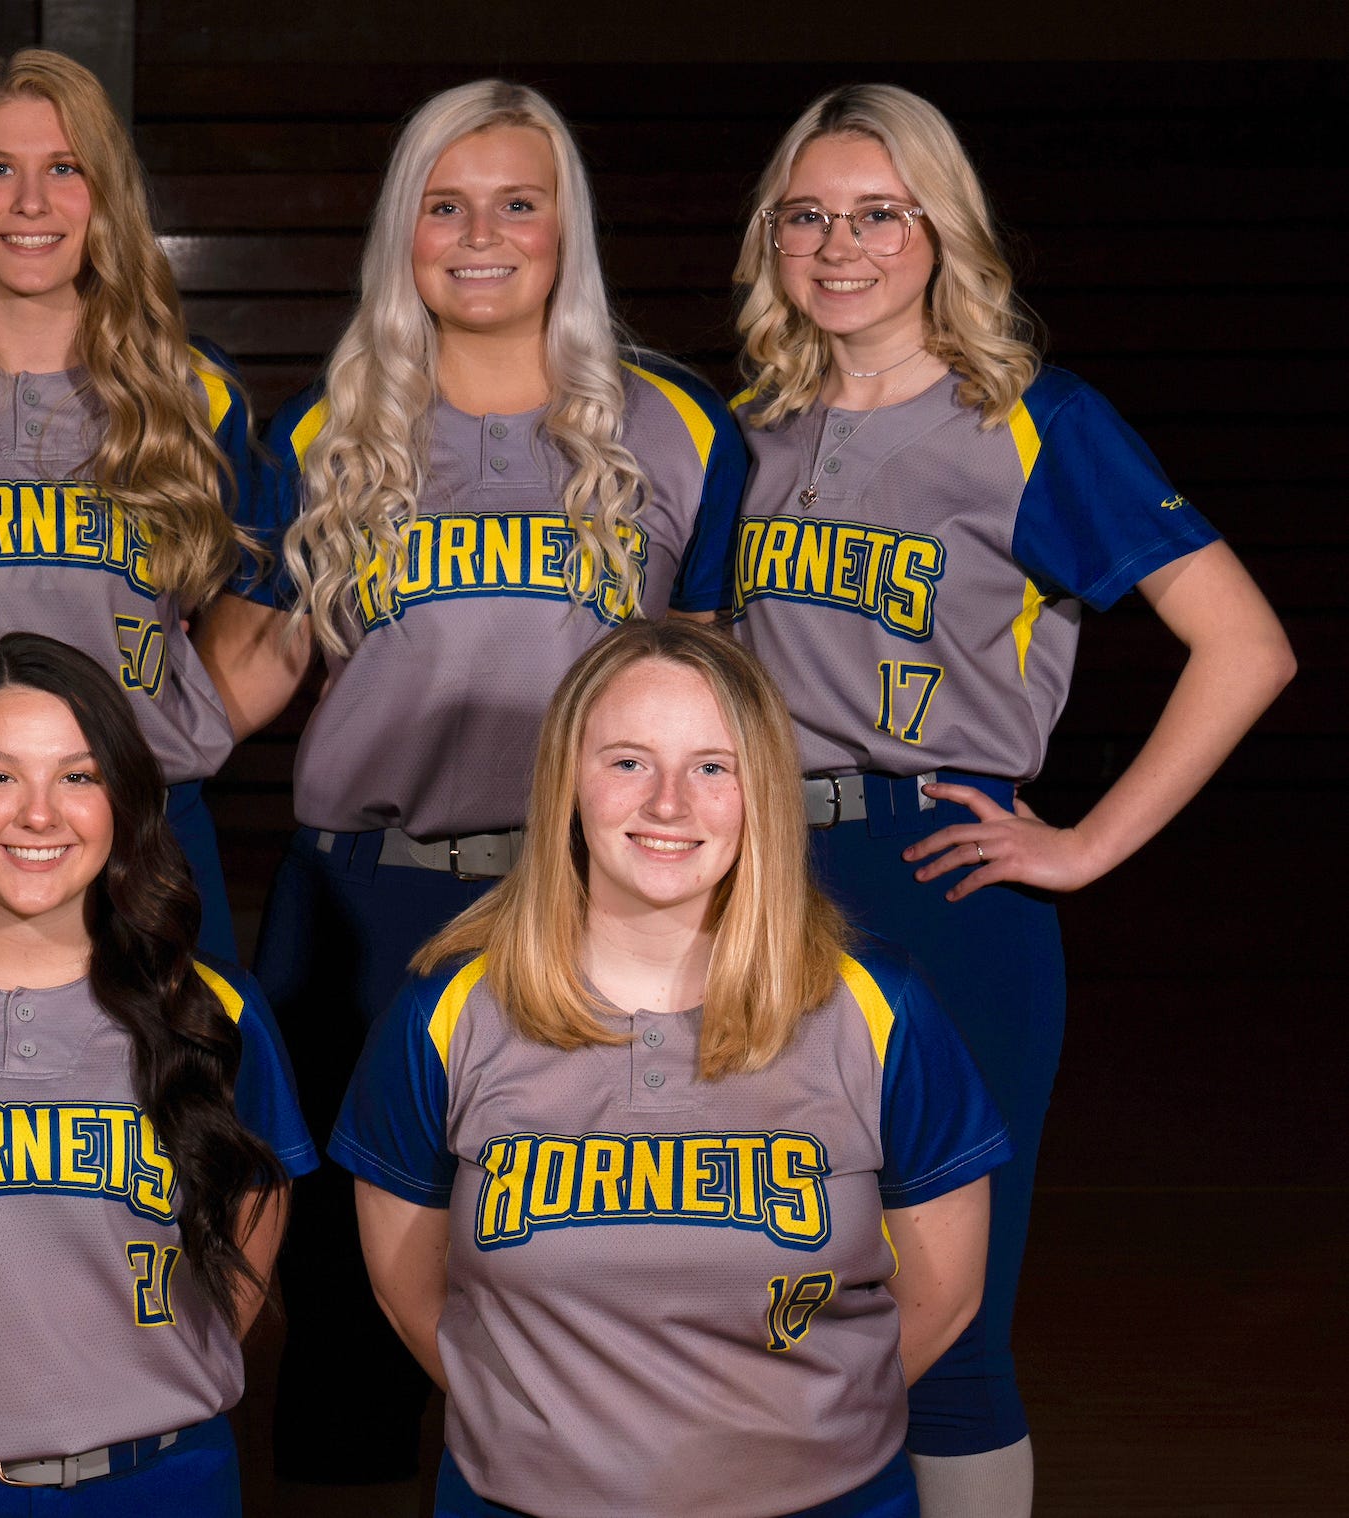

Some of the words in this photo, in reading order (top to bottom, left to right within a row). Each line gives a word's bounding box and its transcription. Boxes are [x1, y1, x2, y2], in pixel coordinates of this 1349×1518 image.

[113, 613, 165, 700] 50
[874, 660, 945, 744] 17
[474, 1129, 834, 1252] HORNETS
[125, 1240, 182, 1327] 21
[766, 1270, 835, 1352] 18
